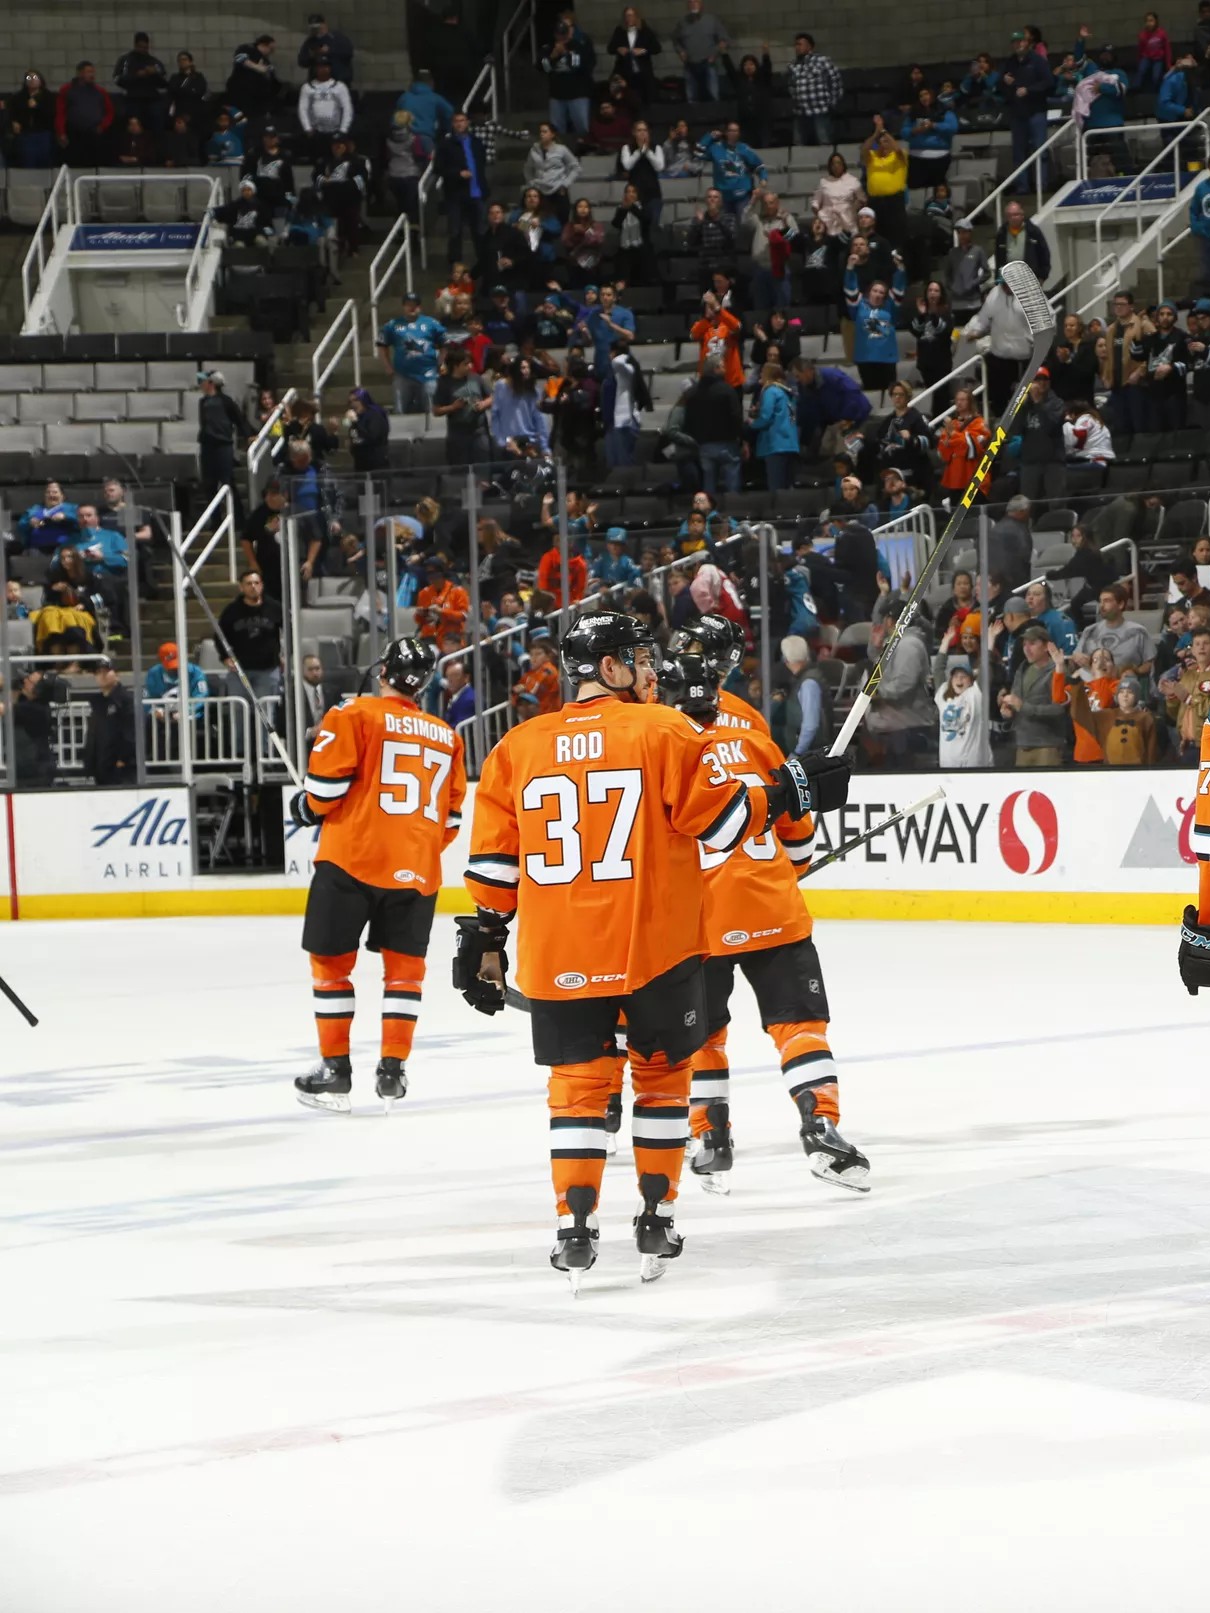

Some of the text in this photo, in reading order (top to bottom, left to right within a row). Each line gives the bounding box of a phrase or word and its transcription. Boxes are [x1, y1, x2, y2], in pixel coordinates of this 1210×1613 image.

[960, 426, 1007, 510] CCM
[404, 674, 419, 686] 57
[690, 685, 704, 698] 86
[311, 729, 336, 753] 7
[555, 730, 604, 764] ROD
[378, 739, 453, 824] 57
[91, 797, 189, 848] Ala
[521, 768, 644, 887] 37
[103, 861, 182, 879] AIRLI
[752, 927, 783, 939] CCM
[590, 972, 628, 984] CCM
